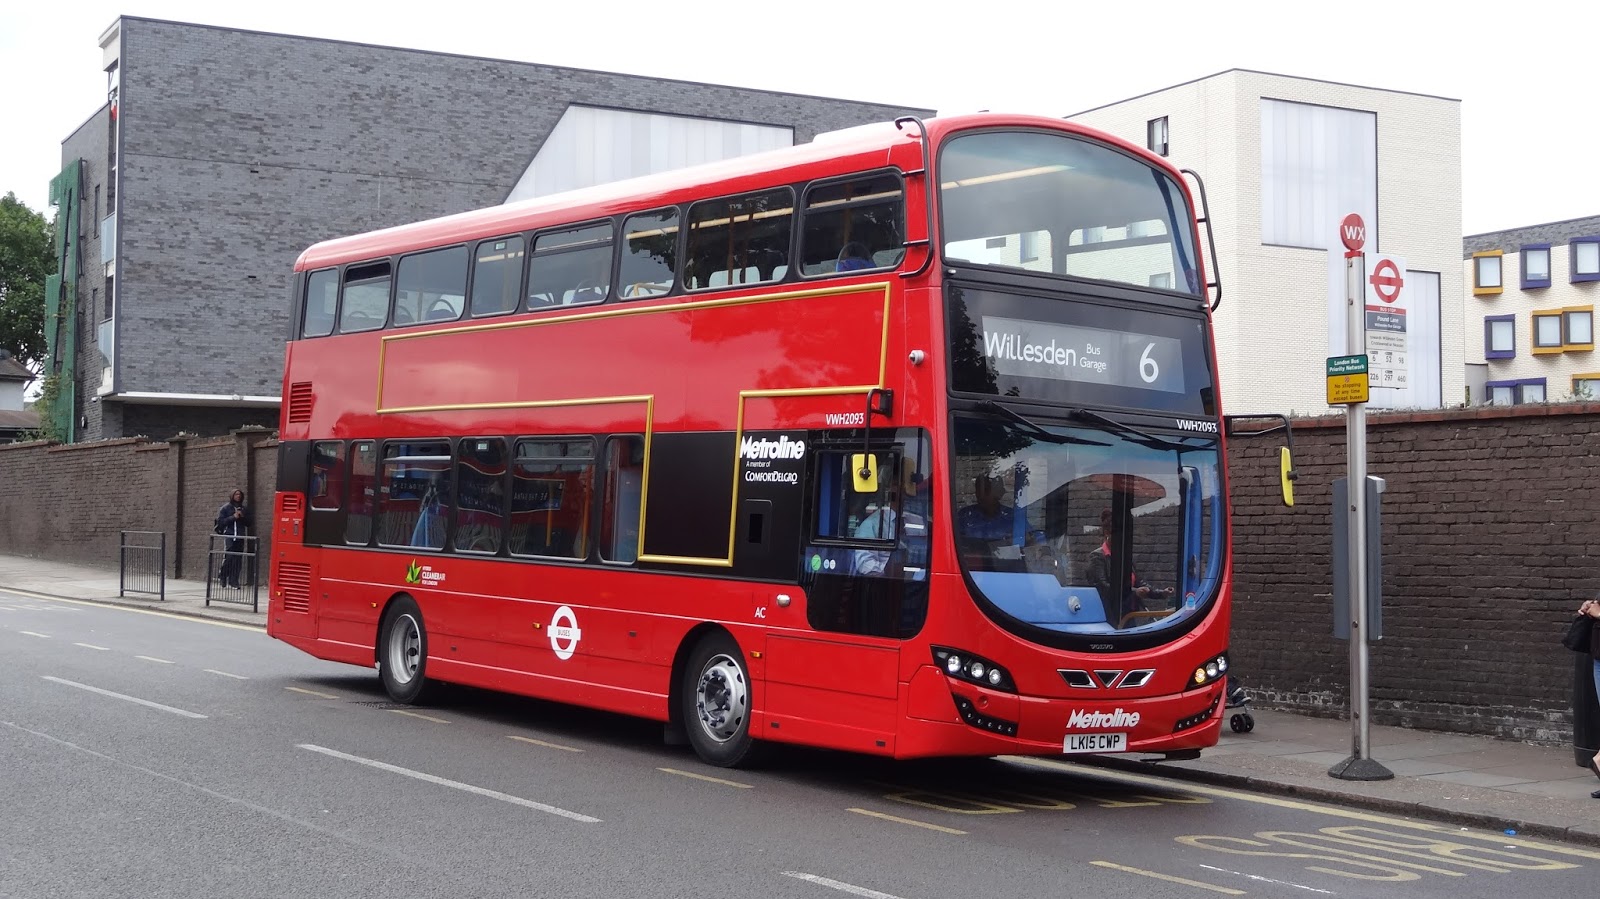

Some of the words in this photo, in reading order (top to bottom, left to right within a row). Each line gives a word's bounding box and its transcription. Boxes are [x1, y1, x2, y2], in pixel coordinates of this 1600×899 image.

[1344, 225, 1365, 241] WX
[984, 331, 1077, 367] Willesden
[1139, 342, 1159, 383] 6
[1086, 343, 1101, 355] Bus
[1079, 356, 1107, 372] Garage
[1385, 355, 1392, 363] 52
[825, 412, 865, 425] VWH2093
[1176, 419, 1218, 433] VWH2093
[739, 435, 805, 460] Metroline
[754, 607, 766, 618] AC
[557, 629, 571, 637] BUSES
[1065, 708, 1140, 729] Metroline
[1070, 735, 1096, 751] LK15
[1097, 734, 1121, 750] CWP
[1174, 825, 1583, 881] BUS
